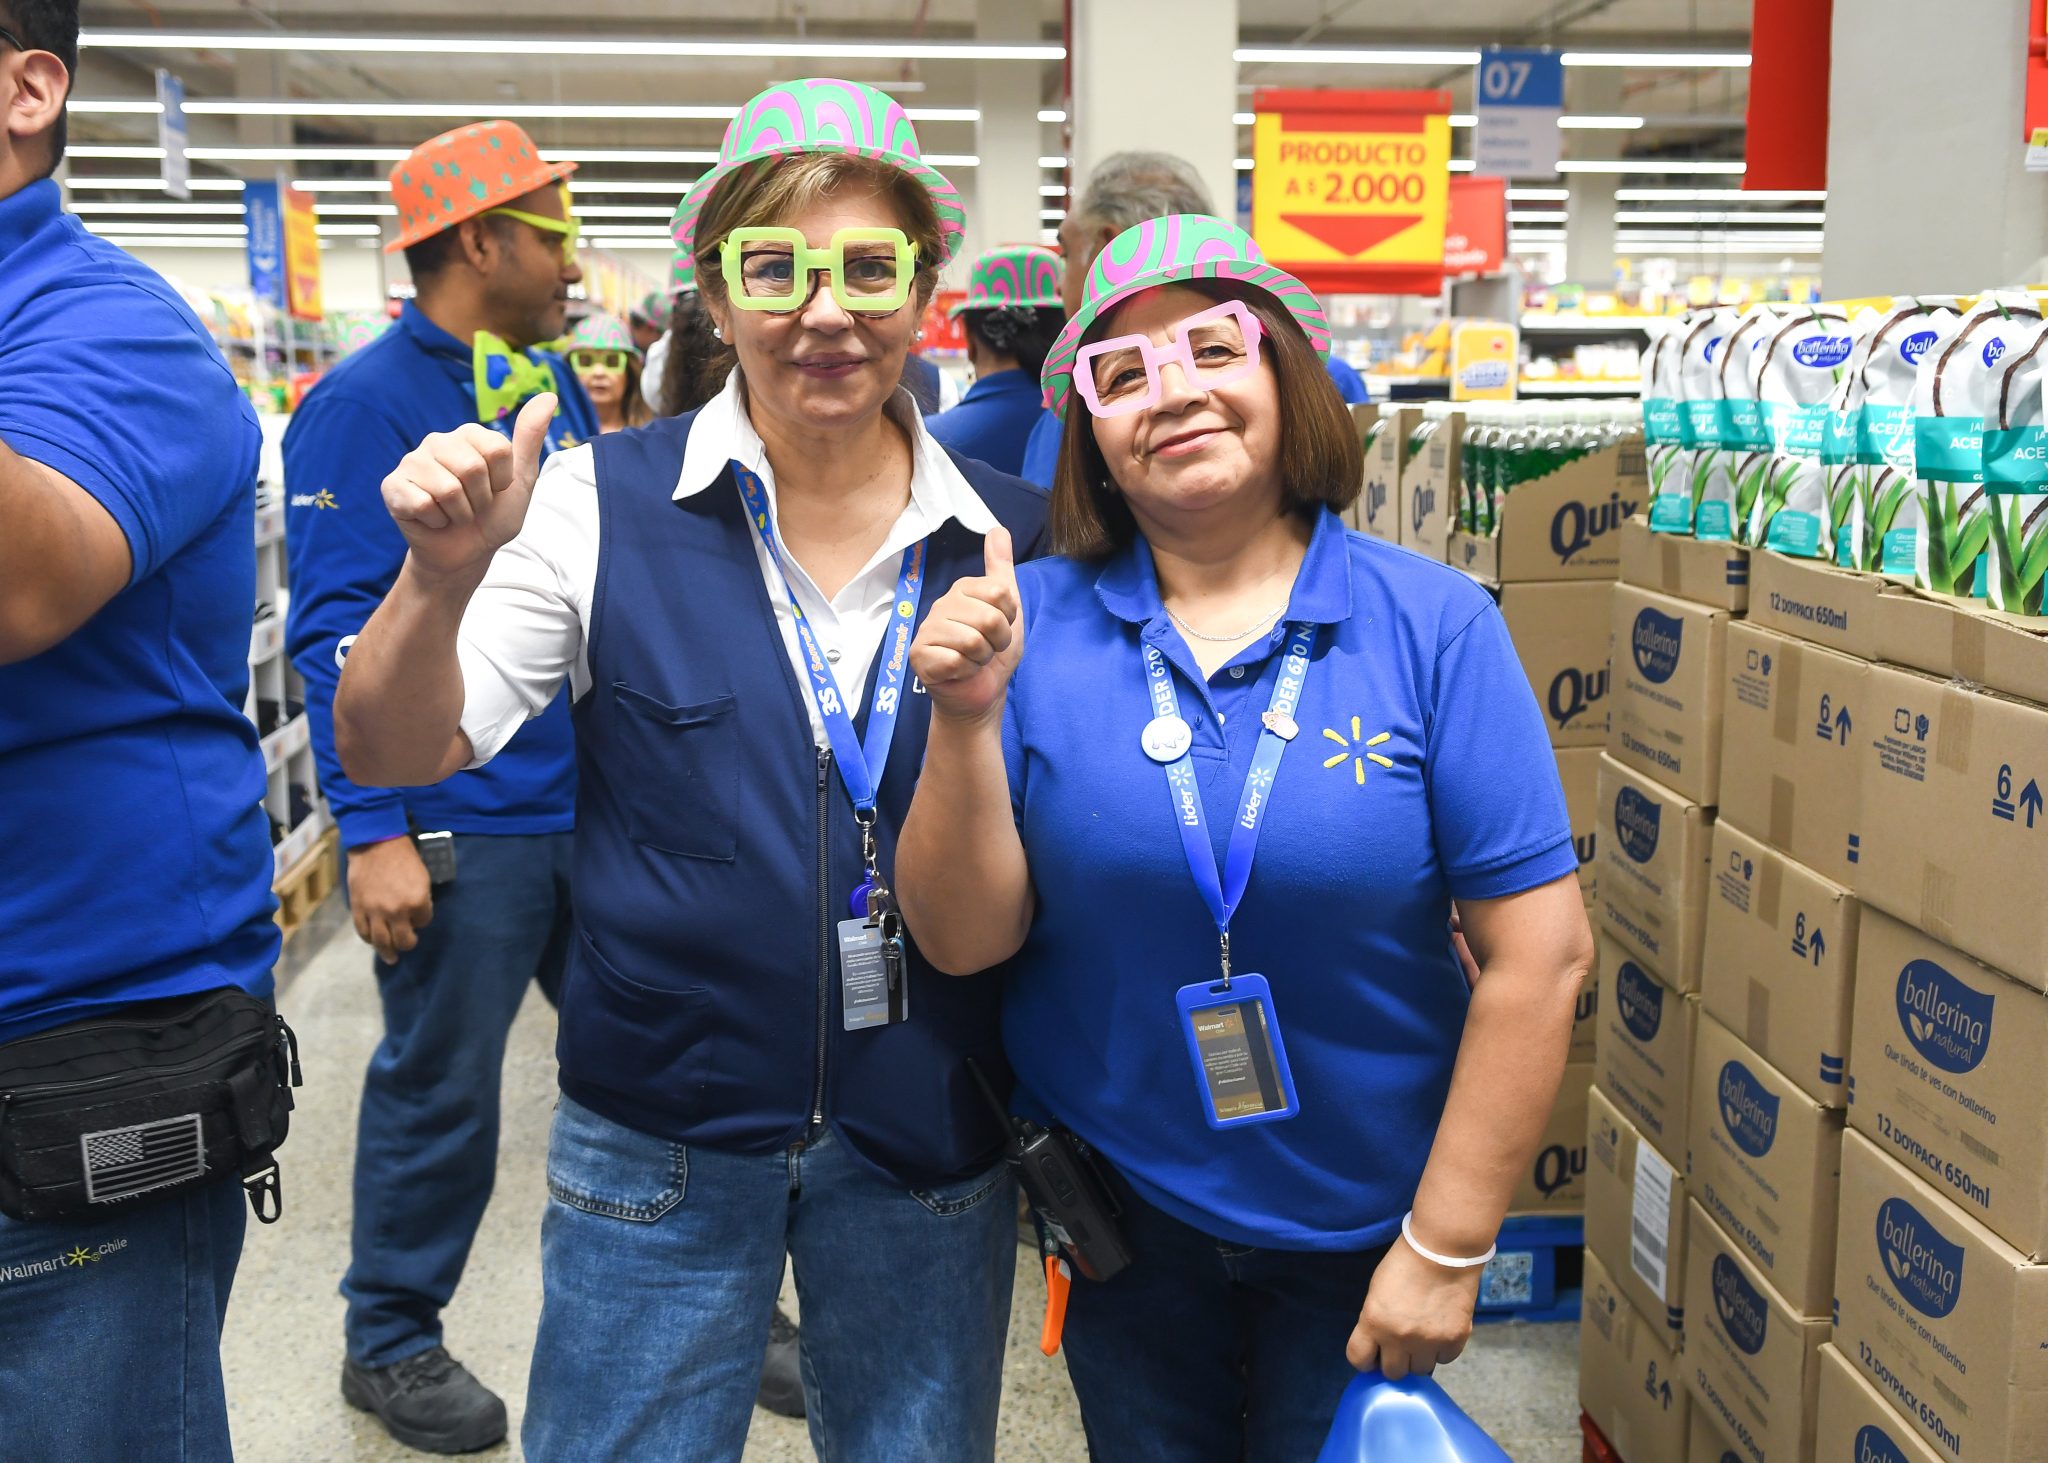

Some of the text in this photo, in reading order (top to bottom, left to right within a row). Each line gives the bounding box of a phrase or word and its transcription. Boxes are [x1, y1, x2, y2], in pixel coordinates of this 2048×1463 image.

[1482, 60, 1532, 99] 07
[1279, 141, 1427, 166] PRODUCTO
[1285, 178, 1300, 196] A
[1323, 172, 1426, 205] 2.000
[1796, 338, 1849, 355] ballerina
[1770, 592, 1848, 631] 12 DOYPACK 650ml
[1635, 619, 1678, 657] ballerina
[1148, 648, 1167, 678] 620
[1286, 643, 1309, 676] 620
[818, 686, 842, 716] 3S
[876, 686, 898, 716] 3S
[1820, 693, 1831, 724] 6
[1997, 763, 2012, 801] 6
[1180, 787, 1199, 827] Lider
[1240, 787, 1263, 830] Lider
[1795, 911, 1806, 941] 6
[1197, 1021, 1225, 1032] Walmart
[1903, 969, 1983, 1046] ballerina
[1933, 1031, 1973, 1064] natural
[1722, 1067, 1773, 1137] ballerina
[1884, 1043, 1900, 1062] Que
[1919, 1067, 1929, 1081] te
[1929, 1075, 1942, 1091] ves
[1942, 1083, 1958, 1101] con
[1958, 1091, 1997, 1125] ballerina
[1877, 1112, 1892, 1139] 12
[1894, 1127, 1943, 1177] DOYPACK
[1944, 1162, 1990, 1209] 650ml
[0, 1238, 128, 1283] Walmart Chile
[1745, 1229, 1775, 1270] 650ml
[1882, 1206, 1954, 1295] ballerina
[1714, 1259, 1764, 1336] ballerina
[1909, 1273, 1945, 1312] natural
[1866, 1274, 1881, 1296] Que
[1897, 1304, 1906, 1320] te
[1905, 1312, 1918, 1331] ves
[1917, 1324, 1932, 1344] con
[1932, 1335, 1967, 1376] ballerina
[1859, 1340, 1873, 1368] 12
[1874, 1359, 1918, 1413] DOYPACK
[1919, 1403, 1961, 1456] 650ml
